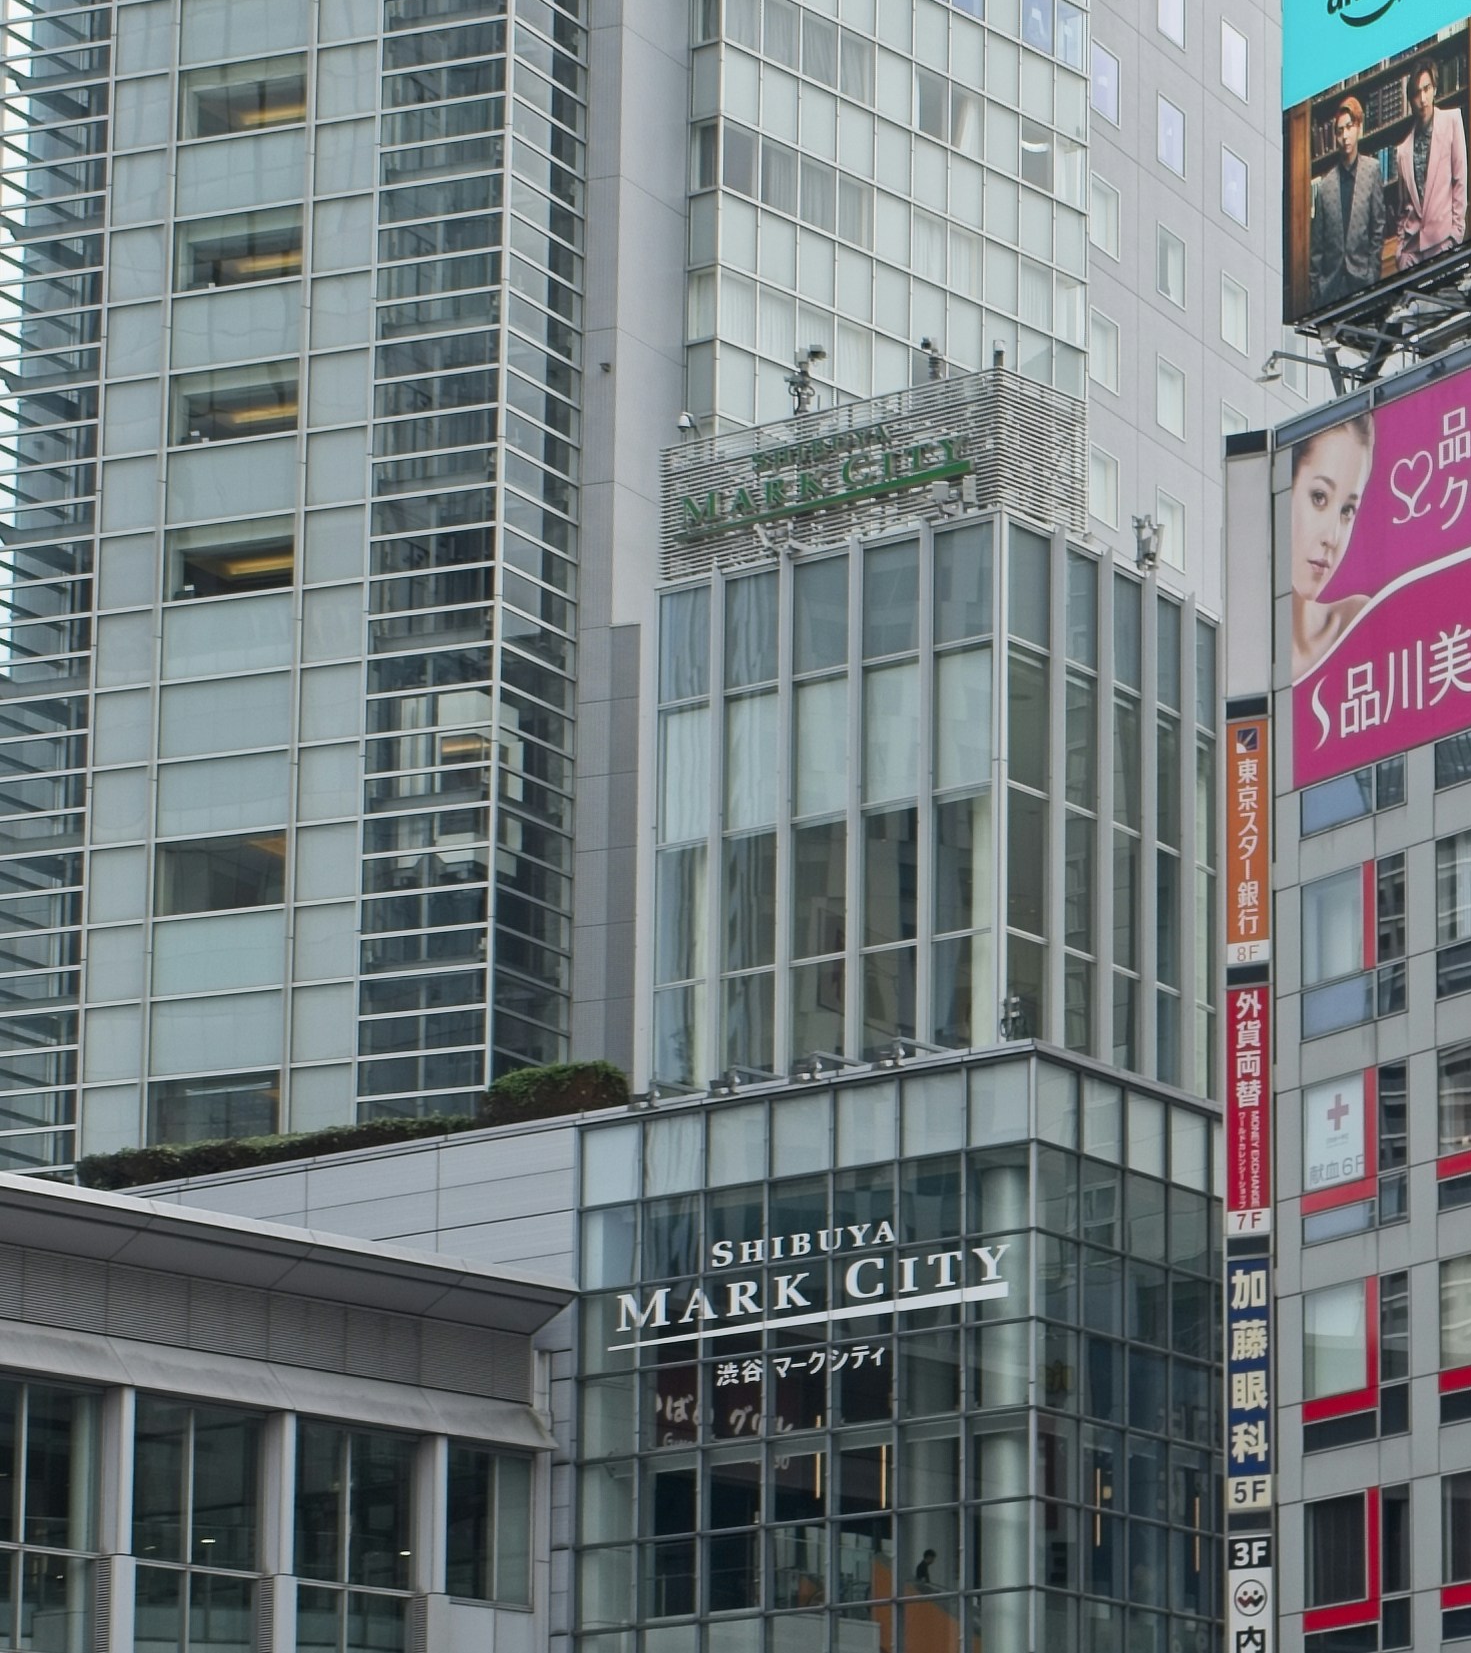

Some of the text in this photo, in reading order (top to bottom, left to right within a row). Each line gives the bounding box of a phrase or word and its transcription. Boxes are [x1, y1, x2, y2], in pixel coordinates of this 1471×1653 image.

[752, 423, 891, 474] SHIBUYA
[681, 433, 967, 529] MARK CITY
[1236, 757, 1260, 935] 東京スター銀行
[1236, 944, 1260, 963] 8F
[1235, 991, 1262, 1108] 外貨両替
[711, 1220, 897, 1269] SHIBUYA
[1236, 1211, 1262, 1231] 7F
[615, 1243, 1013, 1333] MARK CITY
[716, 1344, 887, 1387] 渋谷 マークシティ
[1230, 1269, 1269, 1464] 加藤眼科
[1233, 1479, 1267, 1505] 5F
[1233, 1540, 1268, 1568] 3F
